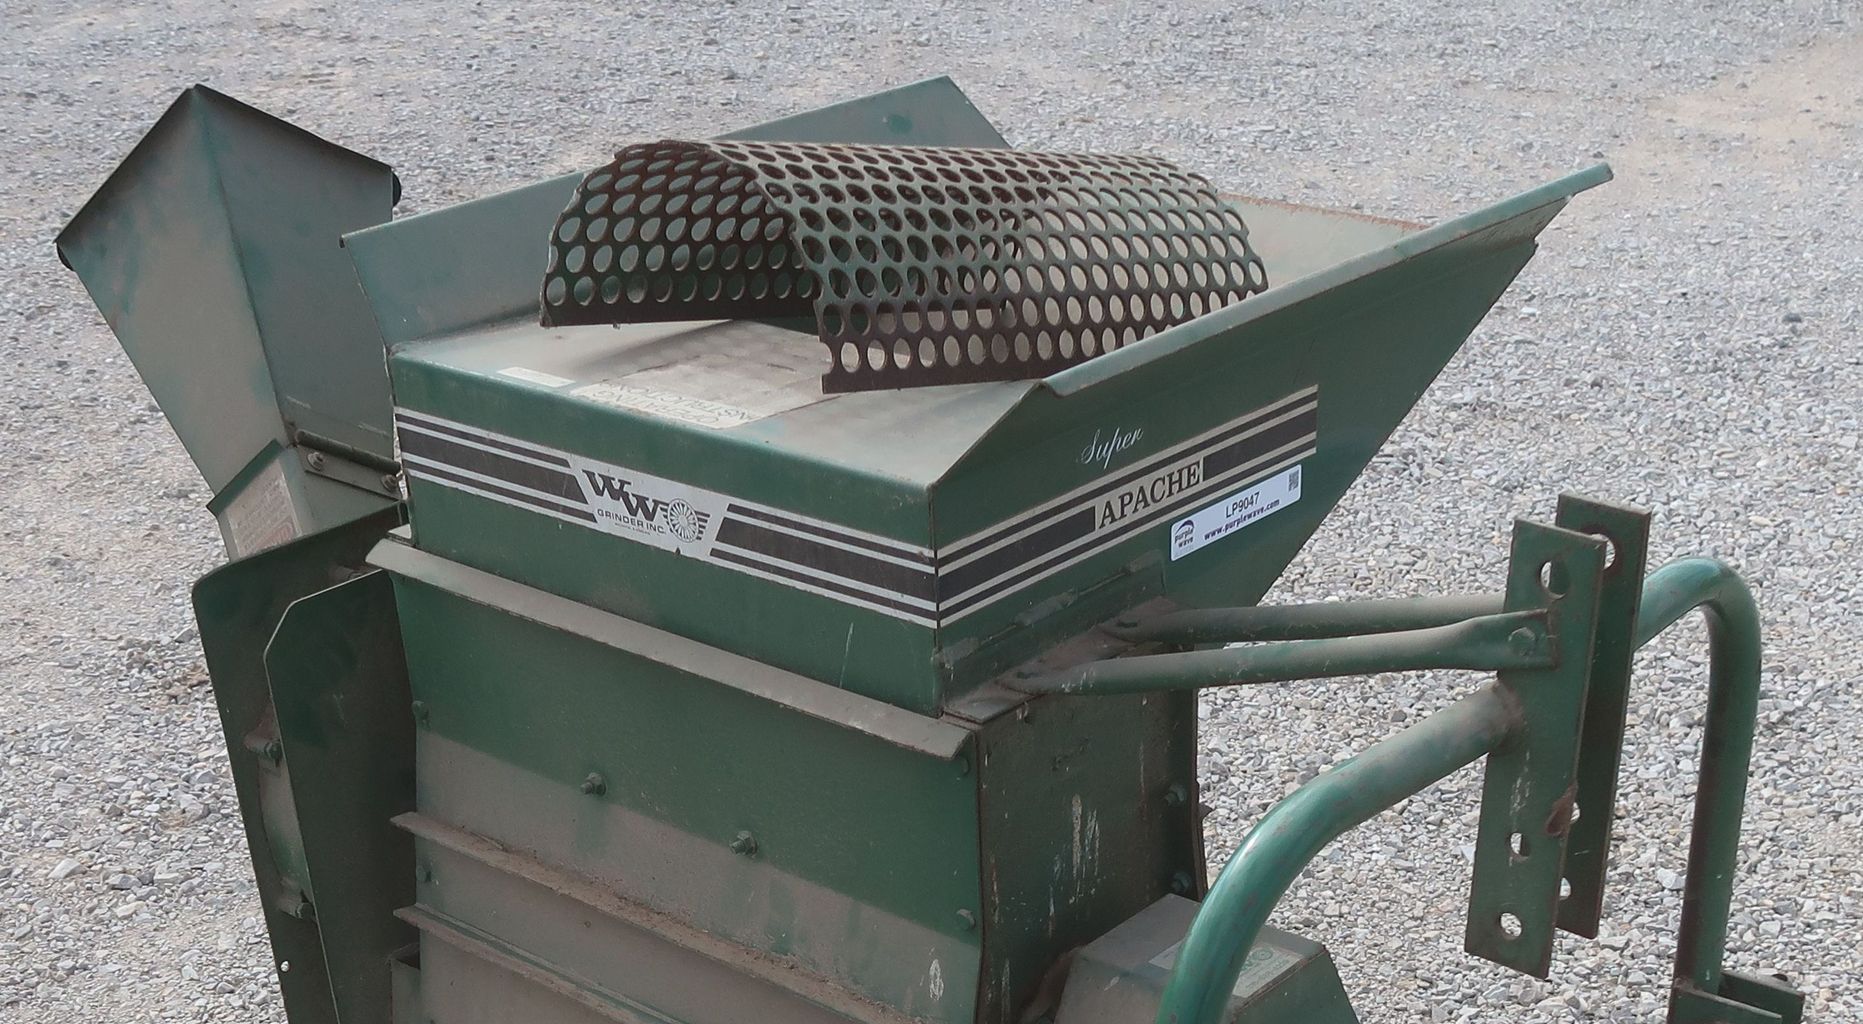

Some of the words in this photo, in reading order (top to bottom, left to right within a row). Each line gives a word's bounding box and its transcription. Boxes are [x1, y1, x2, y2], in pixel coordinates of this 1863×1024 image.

[1079, 427, 1144, 469] Super
[581, 468, 670, 522] WW
[1098, 461, 1200, 529] APACHE
[1225, 491, 1260, 519] LP9047
[597, 508, 645, 528] GRINDER
[1174, 527, 1194, 544] purple
[1203, 498, 1281, 541] www.purplewave.com
[1178, 537, 1194, 549] wave
